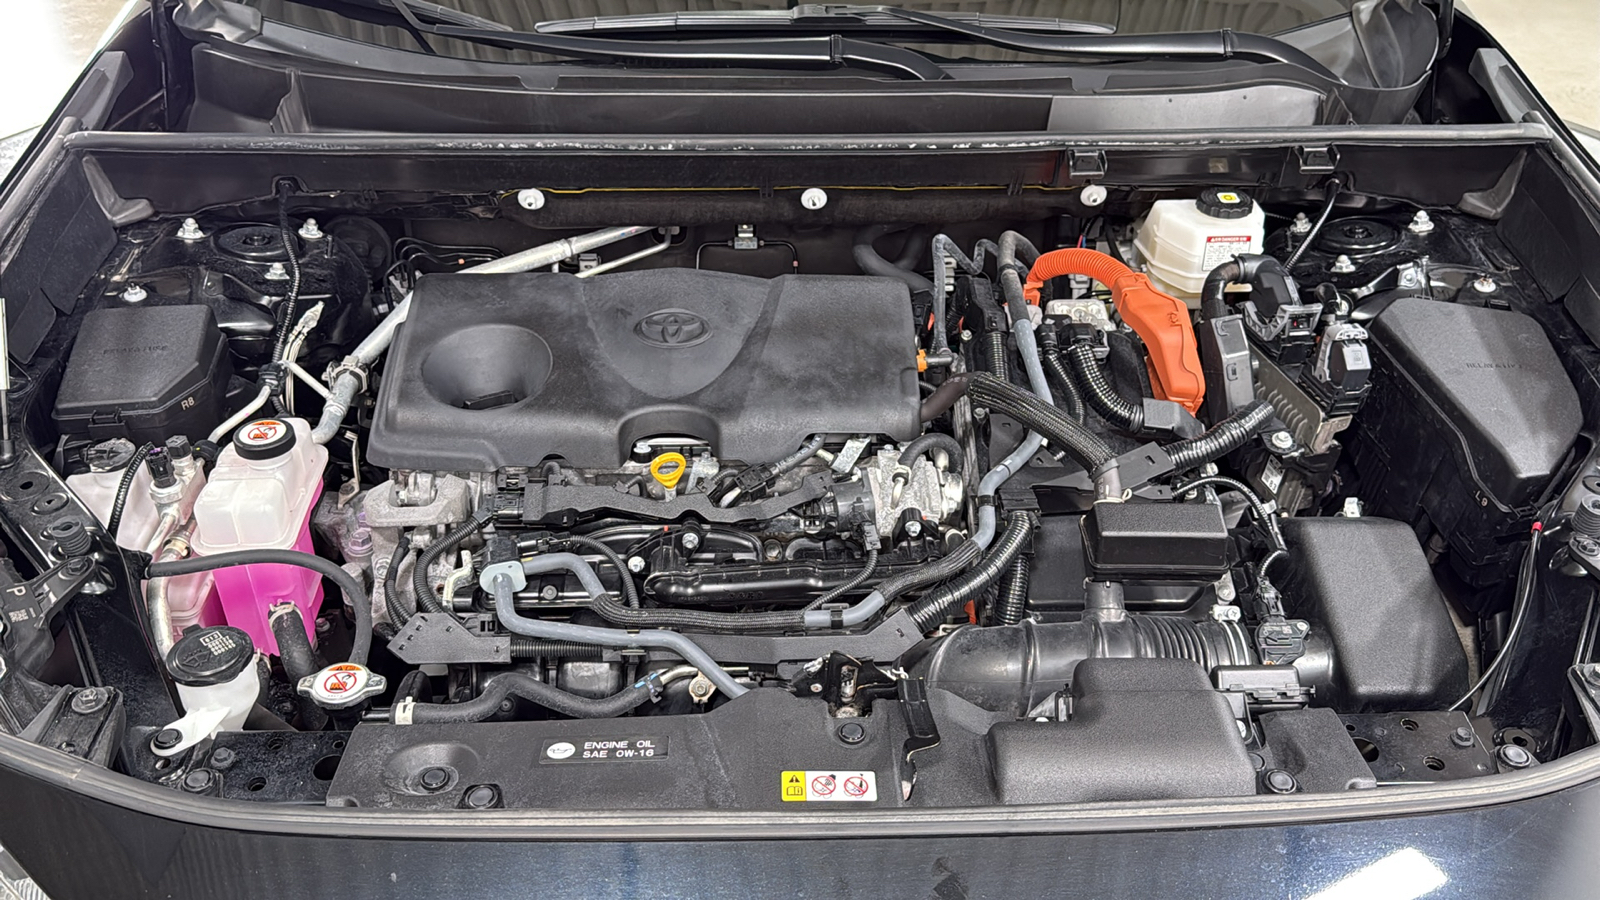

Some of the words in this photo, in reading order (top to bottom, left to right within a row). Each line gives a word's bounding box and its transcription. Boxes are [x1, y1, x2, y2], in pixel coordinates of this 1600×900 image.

[181, 397, 195, 411] R8
[6, 585, 26, 596] P
[584, 741, 629, 750] ENGINE
[636, 740, 656, 748] OIL
[582, 750, 608, 758] SAE
